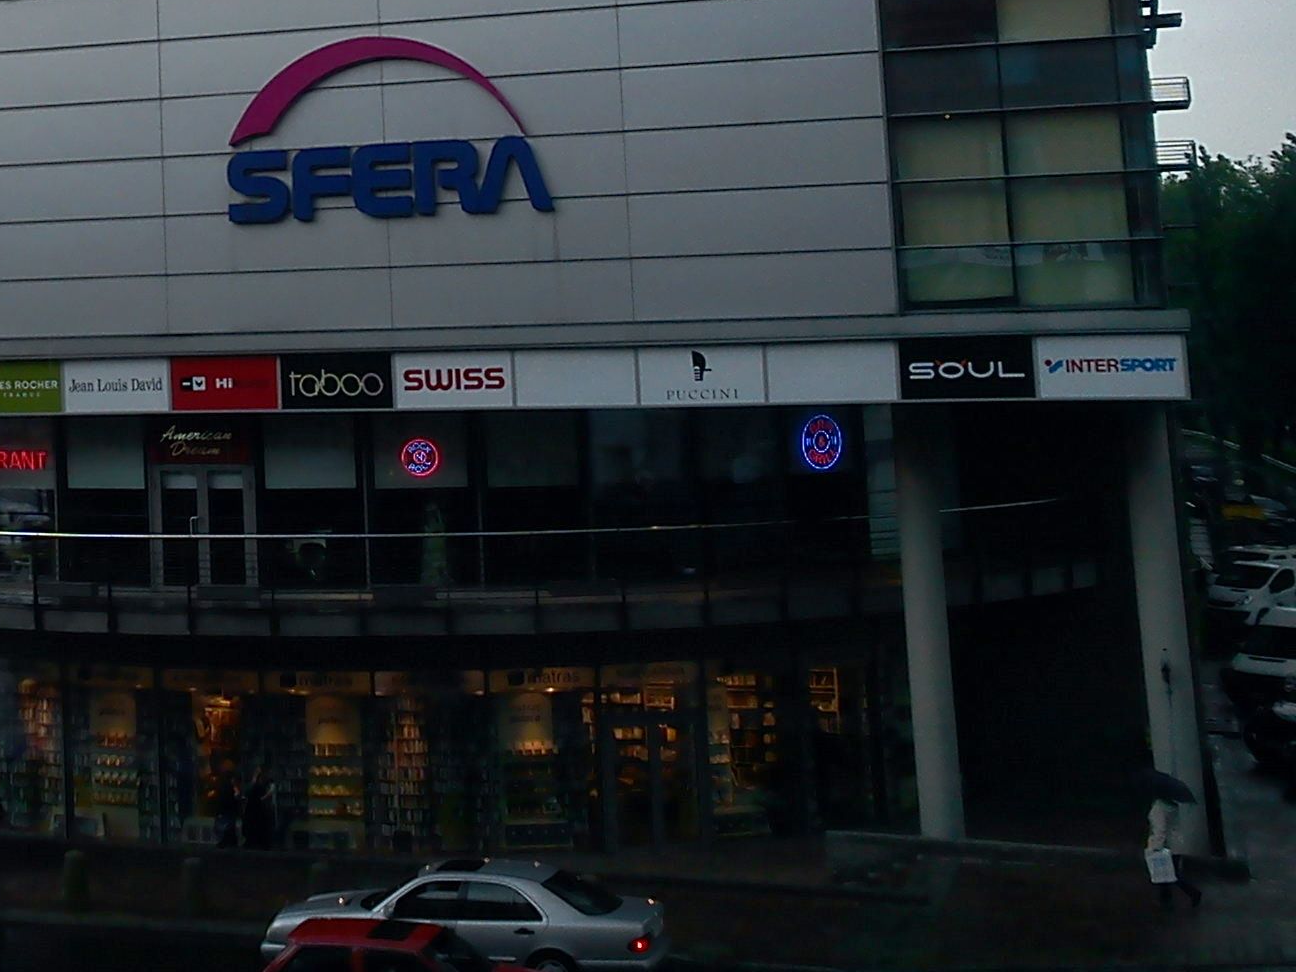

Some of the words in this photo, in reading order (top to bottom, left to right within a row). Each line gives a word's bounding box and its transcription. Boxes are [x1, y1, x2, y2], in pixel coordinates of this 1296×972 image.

[226, 136, 555, 225] SFERA
[908, 360, 1026, 380] SOUL
[1065, 358, 1178, 373] INTERSPORT
[14, 379, 58, 390] ROCHER
[68, 379, 95, 393] Jean
[96, 378, 128, 393] Louis
[131, 378, 163, 392] David
[289, 369, 385, 397] taboo
[403, 367, 506, 392] SWISS
[665, 389, 740, 401] PUCCINI
[160, 425, 233, 443] American
